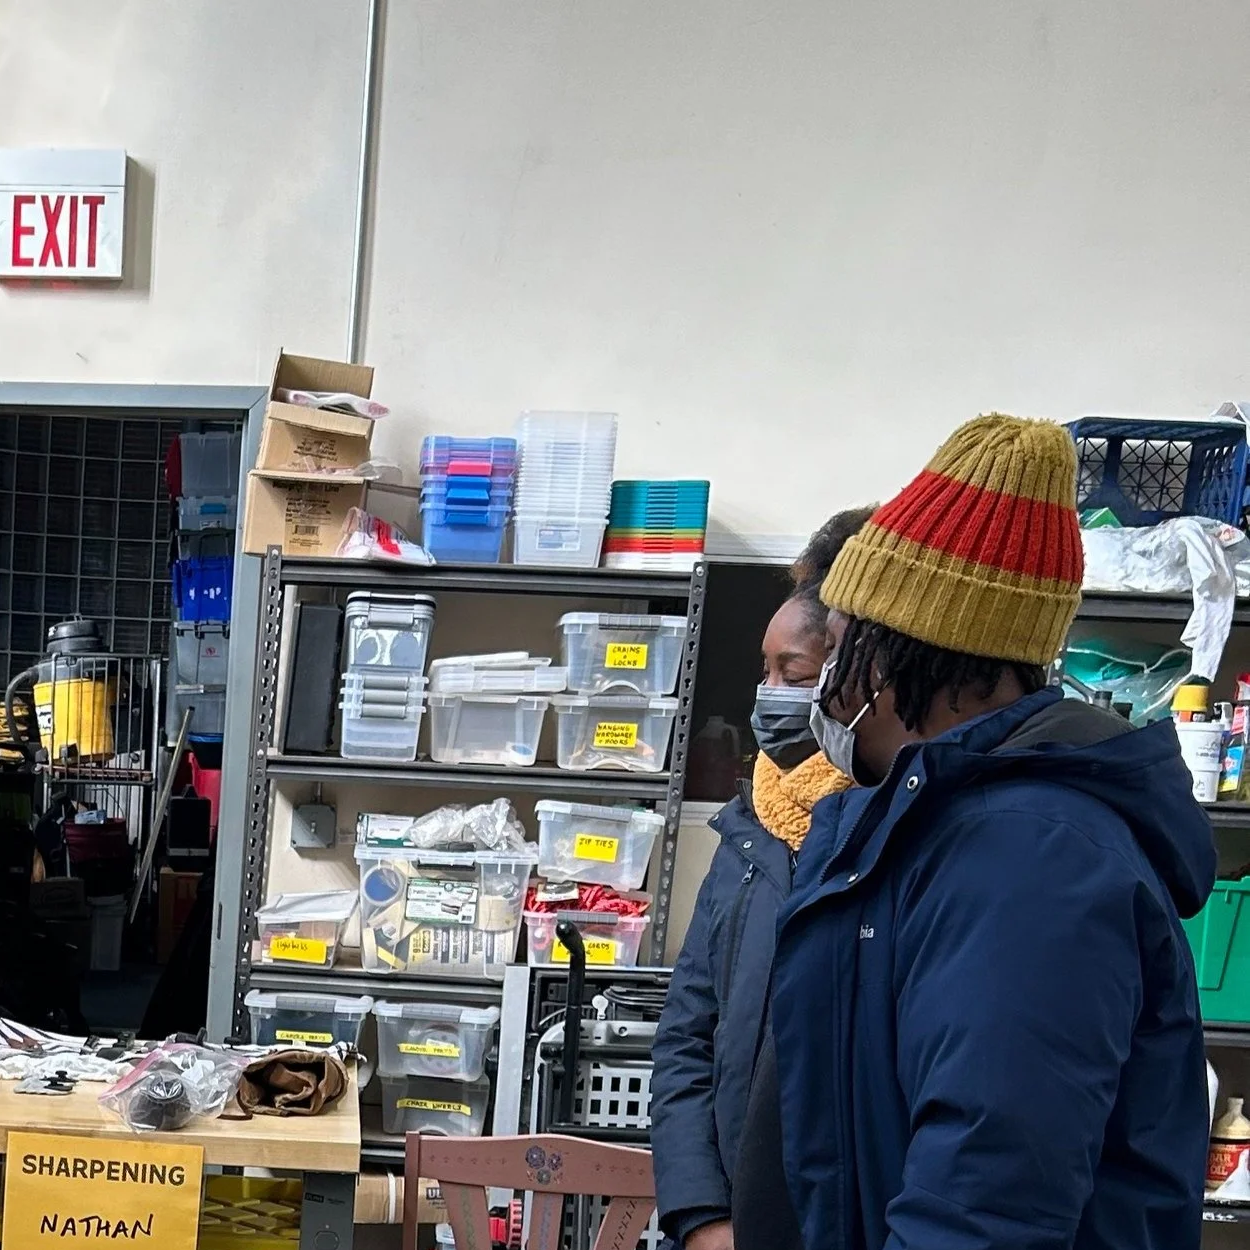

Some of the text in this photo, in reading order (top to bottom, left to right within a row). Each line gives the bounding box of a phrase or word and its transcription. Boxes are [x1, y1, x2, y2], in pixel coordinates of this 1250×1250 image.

[11, 194, 106, 269] EXIT
[22, 1154, 186, 1187] SHARPENING
[40, 1213, 155, 1240] NATHAN
